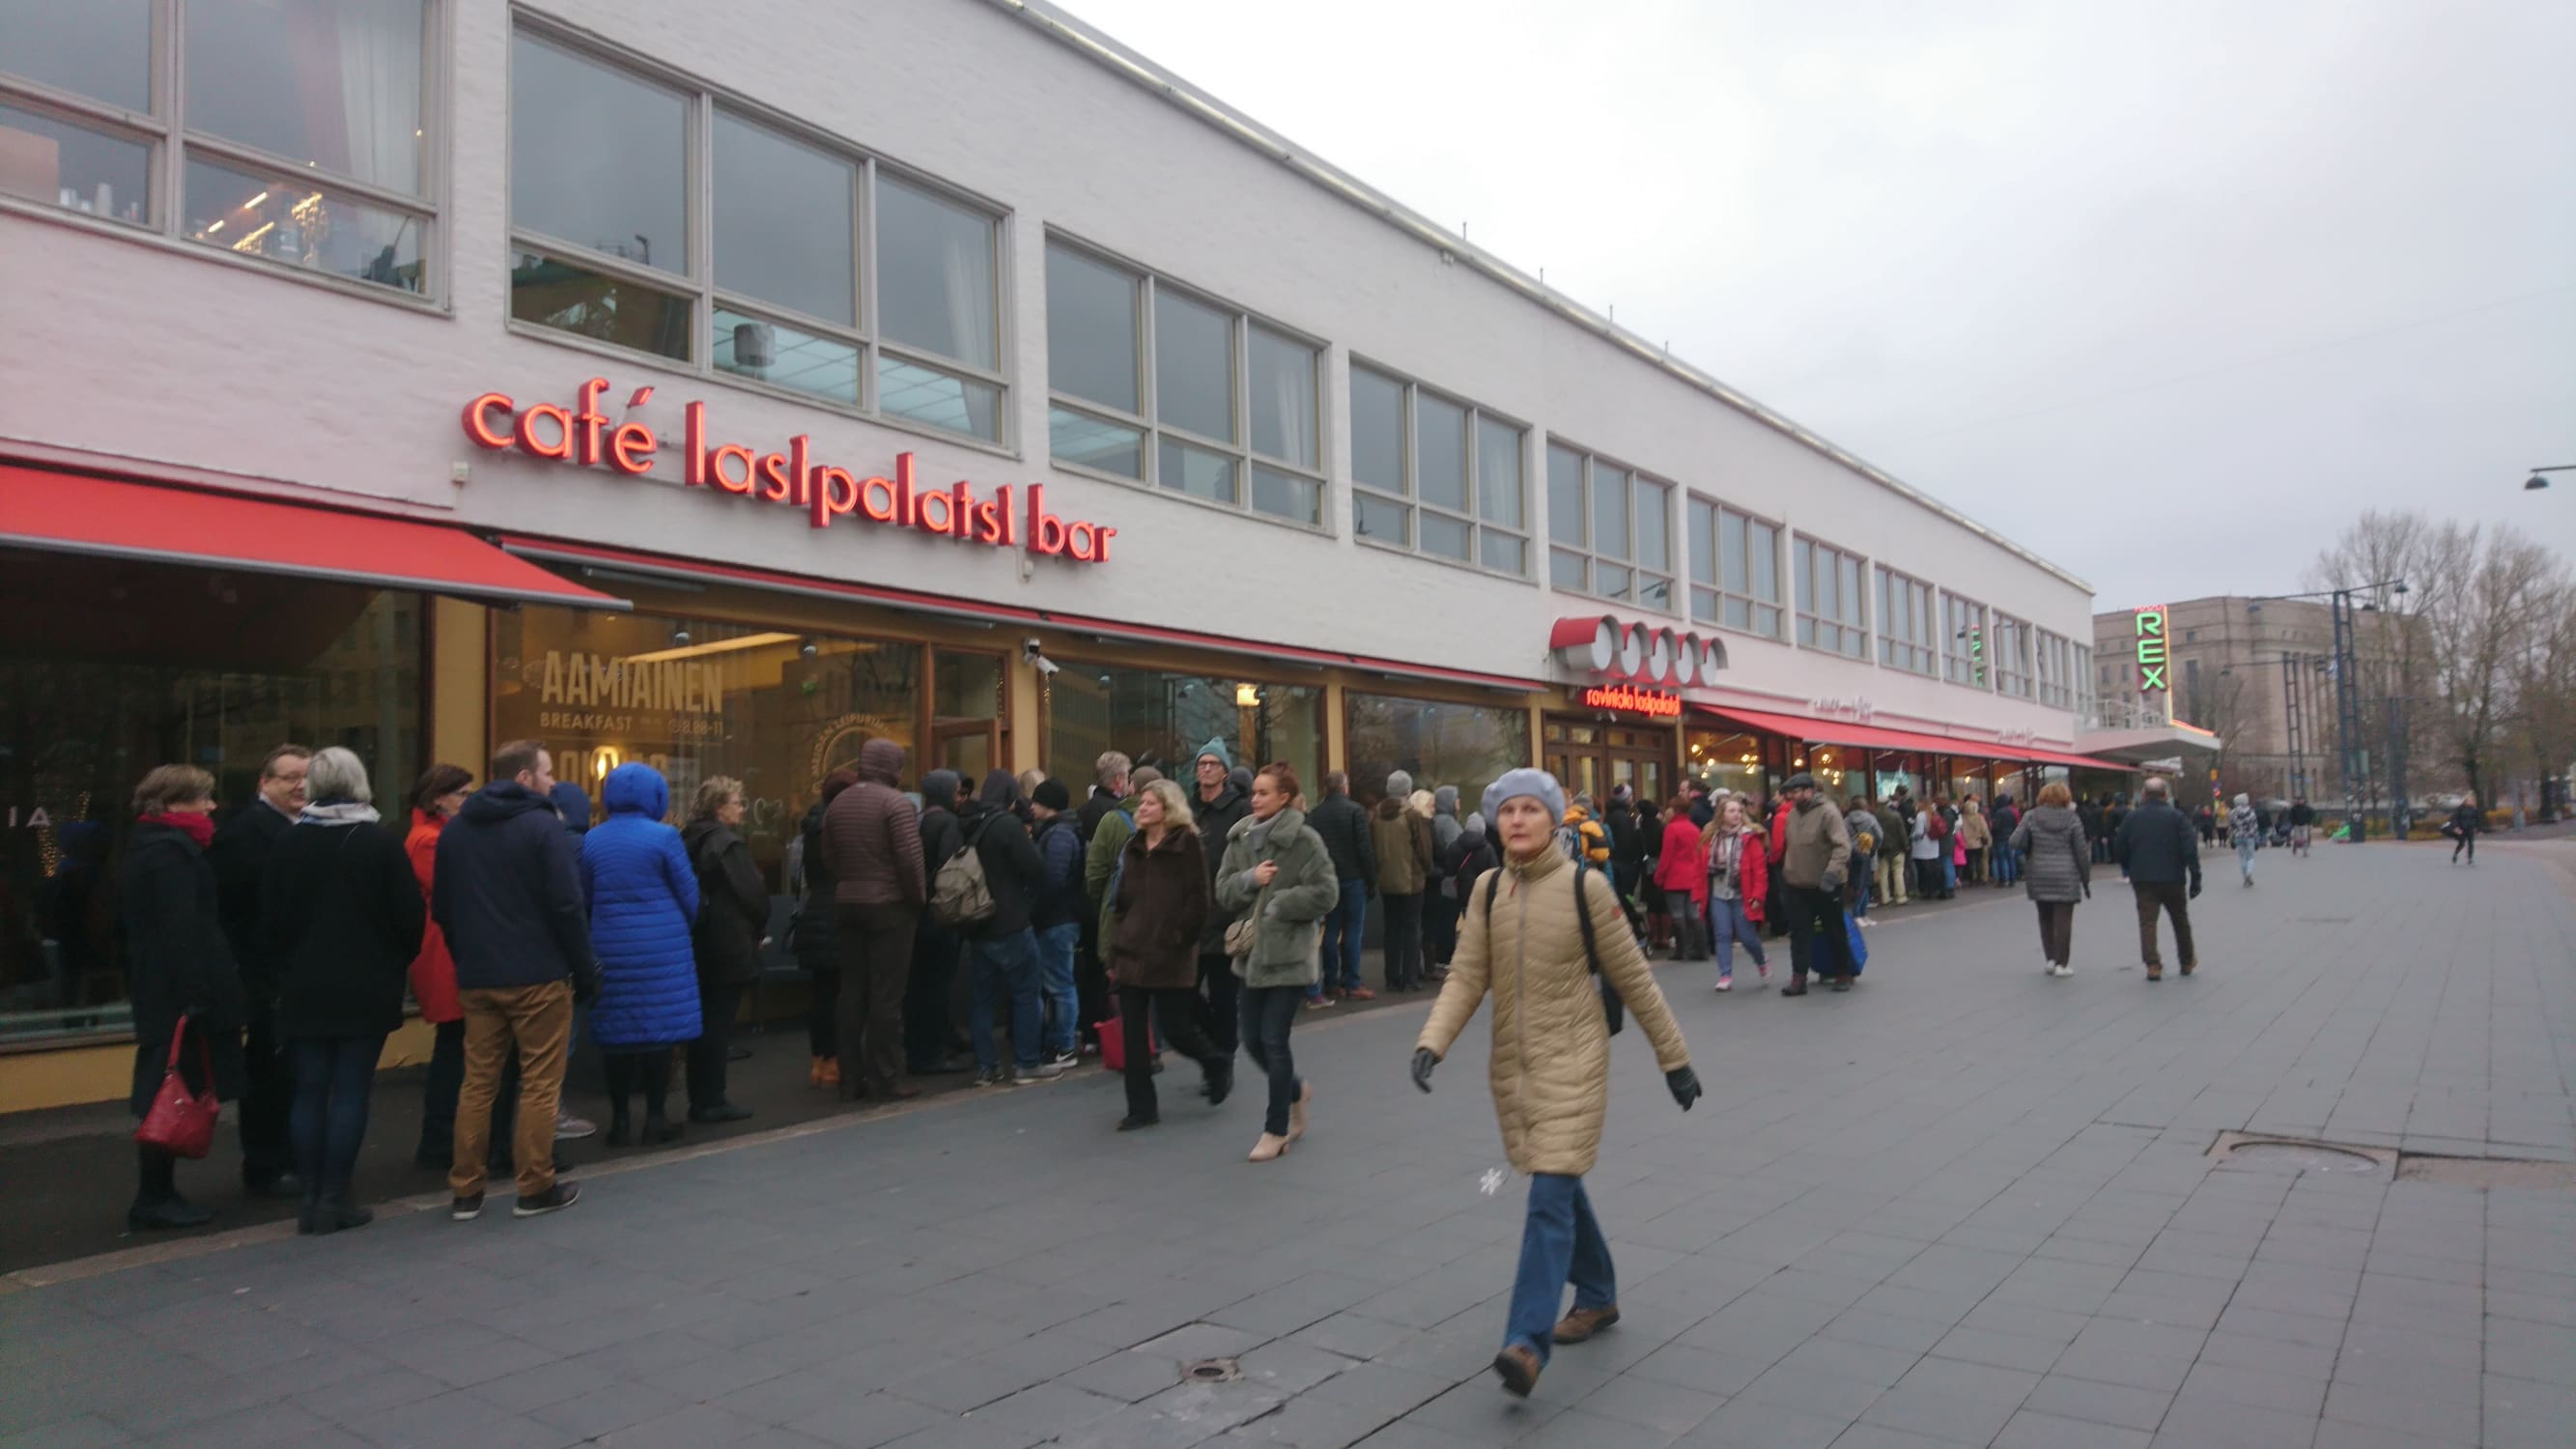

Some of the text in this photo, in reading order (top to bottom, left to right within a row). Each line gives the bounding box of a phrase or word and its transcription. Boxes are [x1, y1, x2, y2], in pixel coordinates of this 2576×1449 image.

[462, 378, 658, 474] café
[1027, 483, 1118, 563] bar
[541, 650, 722, 713] AAMIAINEN
[2136, 611, 2166, 691] REX
[540, 712, 633, 731] BREAKFAST
